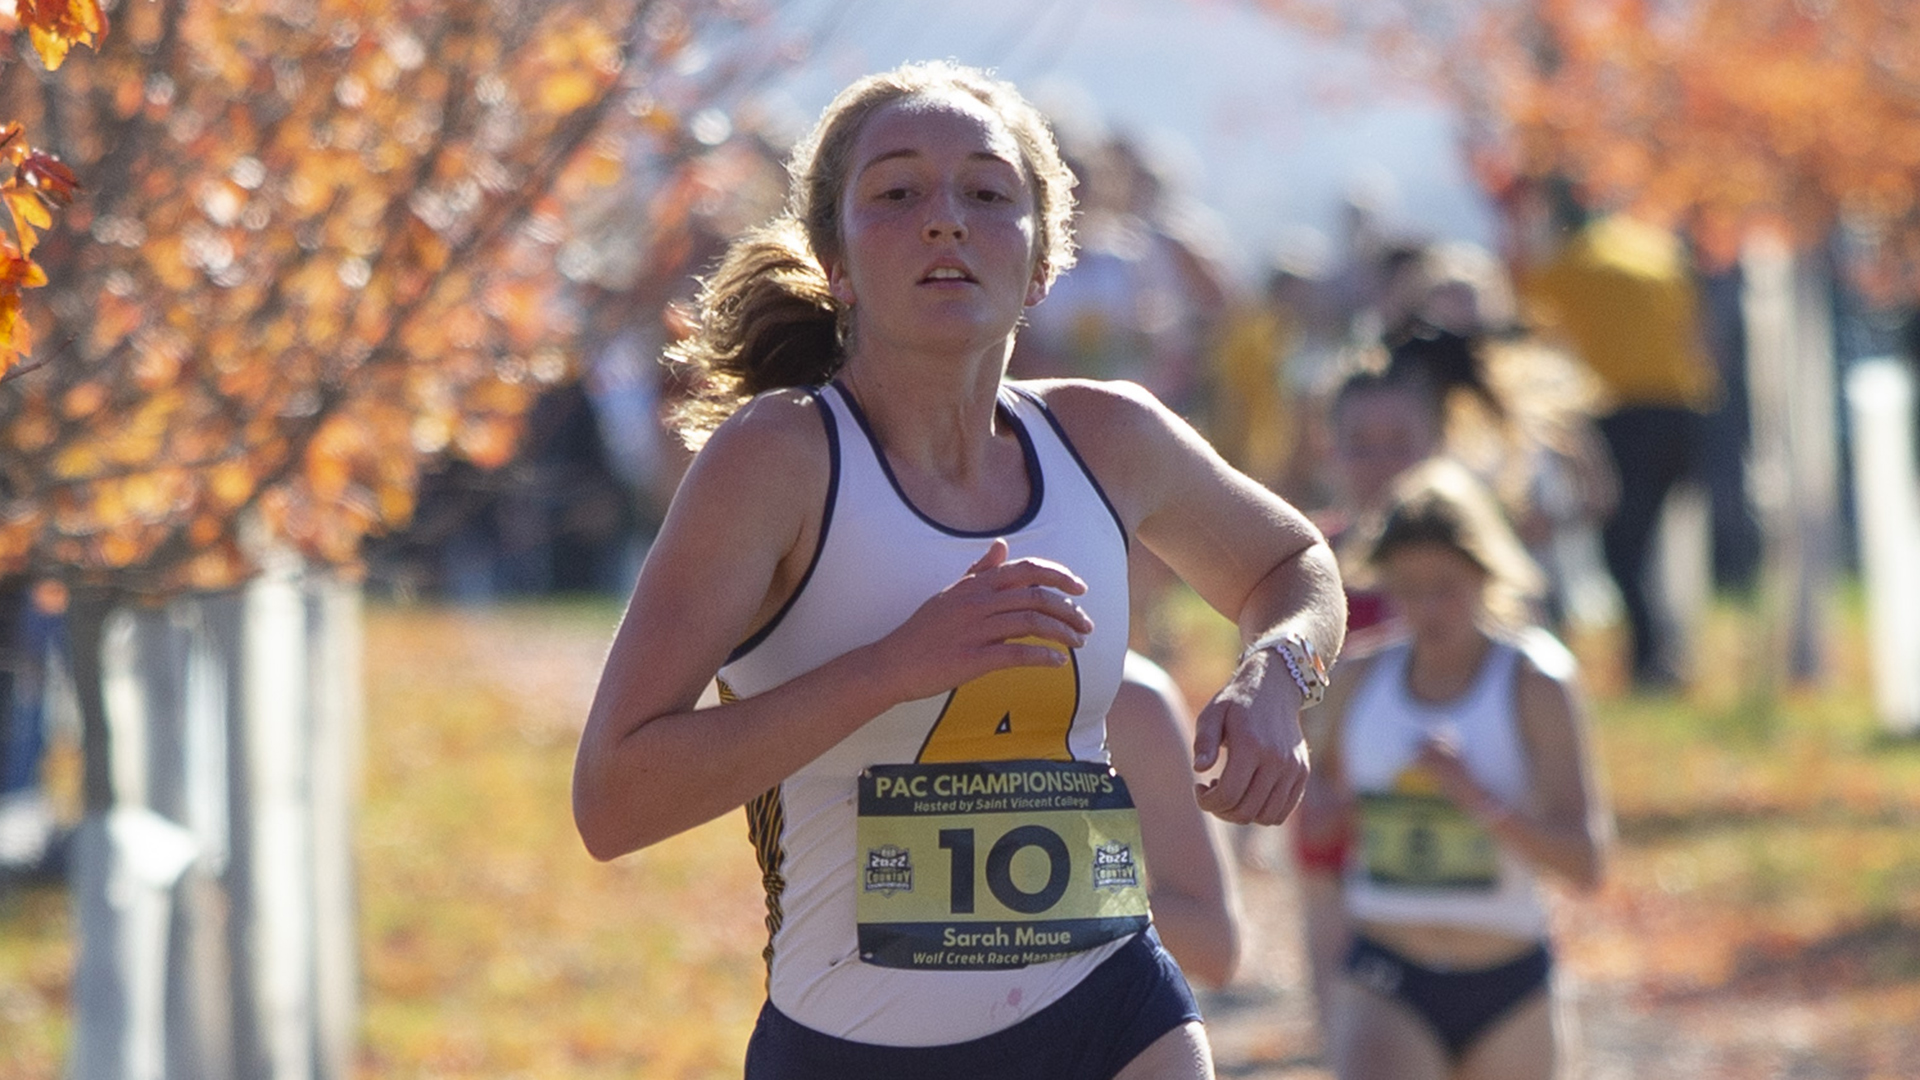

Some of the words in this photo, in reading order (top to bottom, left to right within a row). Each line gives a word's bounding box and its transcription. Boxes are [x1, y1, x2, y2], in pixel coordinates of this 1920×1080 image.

[876, 776, 928, 798] PAC
[933, 771, 1114, 796] CHAMPIONSHIPS
[914, 801, 957, 812] Hosted
[959, 800, 974, 812] by
[976, 799, 1007, 810] Saint
[1011, 797, 1053, 809] Vincent
[1054, 796, 1089, 808] College
[938, 825, 1071, 914] 10
[943, 927, 1009, 947] Sarah
[1015, 927, 1071, 946] Maue
[913, 952, 943, 964] Wolf
[946, 952, 984, 964] Creek
[987, 953, 1018, 964] Race
